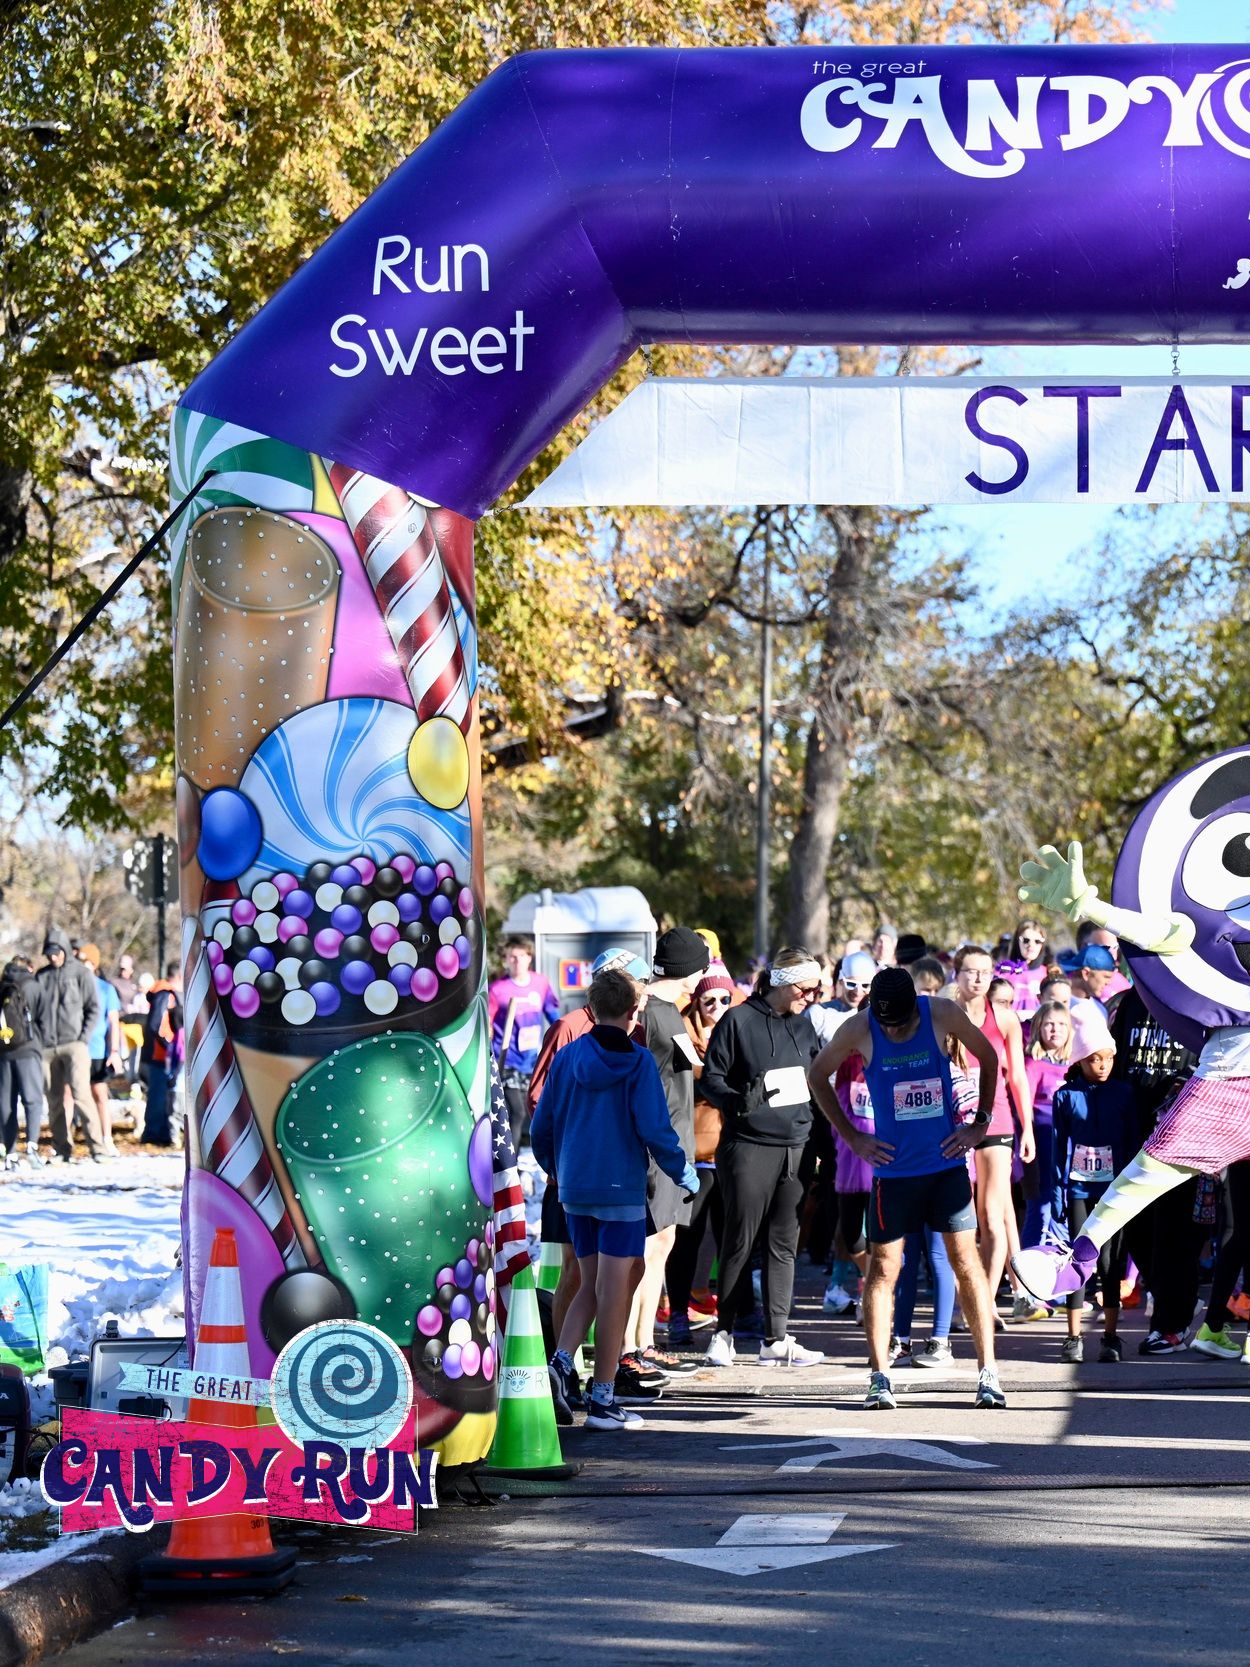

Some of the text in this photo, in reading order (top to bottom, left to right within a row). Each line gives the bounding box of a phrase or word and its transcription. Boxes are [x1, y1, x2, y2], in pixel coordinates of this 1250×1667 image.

[812, 60, 927, 78] the great
[800, 73, 1225, 179] CANDY
[372, 234, 490, 296] Run
[328, 310, 535, 378] Sweet
[882, 1050, 930, 1065] ENDURANCE
[908, 1057, 930, 1069] TEAM
[904, 1090, 933, 1107] 488
